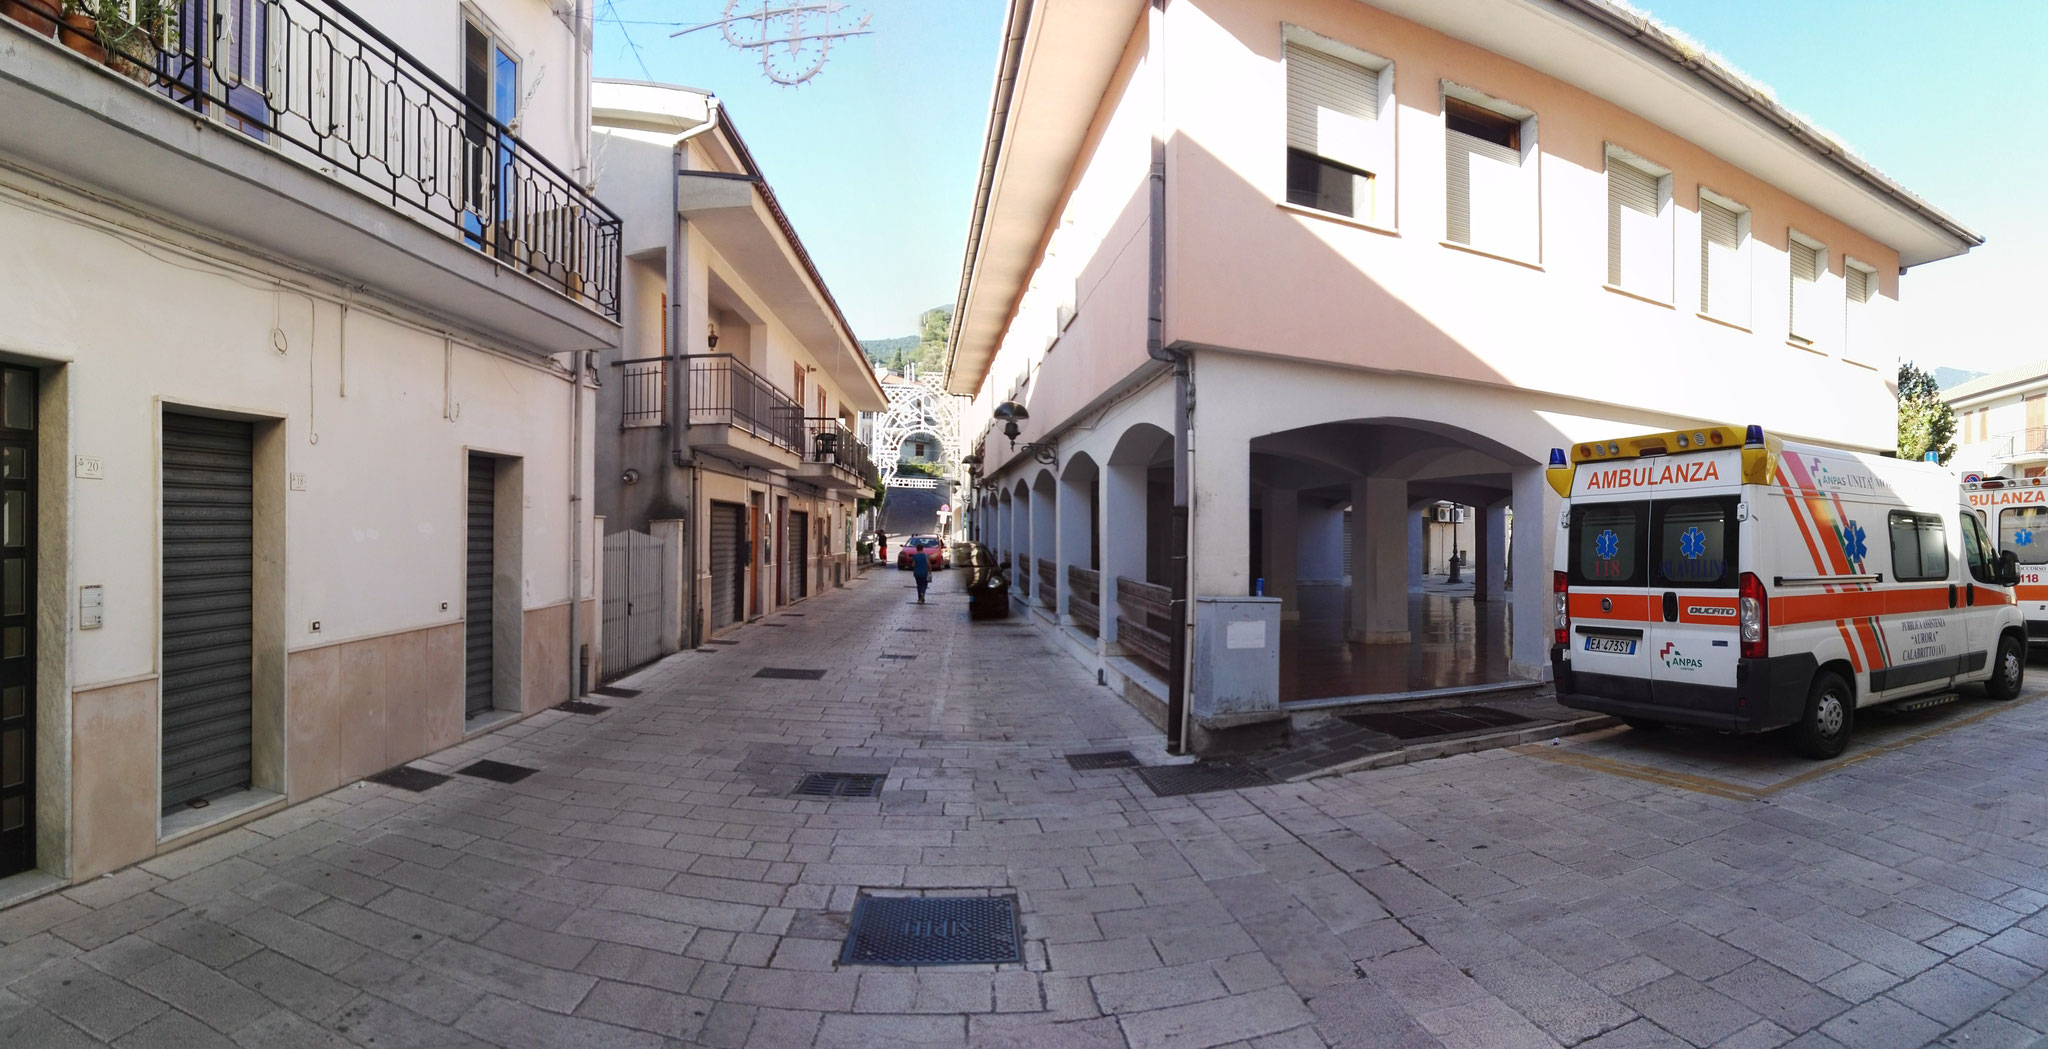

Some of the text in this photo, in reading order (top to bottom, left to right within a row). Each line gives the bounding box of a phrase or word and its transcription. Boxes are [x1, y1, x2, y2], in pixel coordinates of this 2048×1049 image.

[87, 461, 99, 472] 20
[1587, 460, 1719, 489] AMBULANZA
[1822, 475, 1846, 486] ANPAS
[1968, 490, 2046, 506] BULANZA
[1594, 560, 1620, 577] 118
[2020, 573, 2039, 583] 118
[1689, 607, 1735, 616] DUCATO
[1590, 638, 1630, 652] EA 473SY
[1902, 645, 1935, 661] CALABRITTO
[1672, 657, 1703, 668] ANPAS
